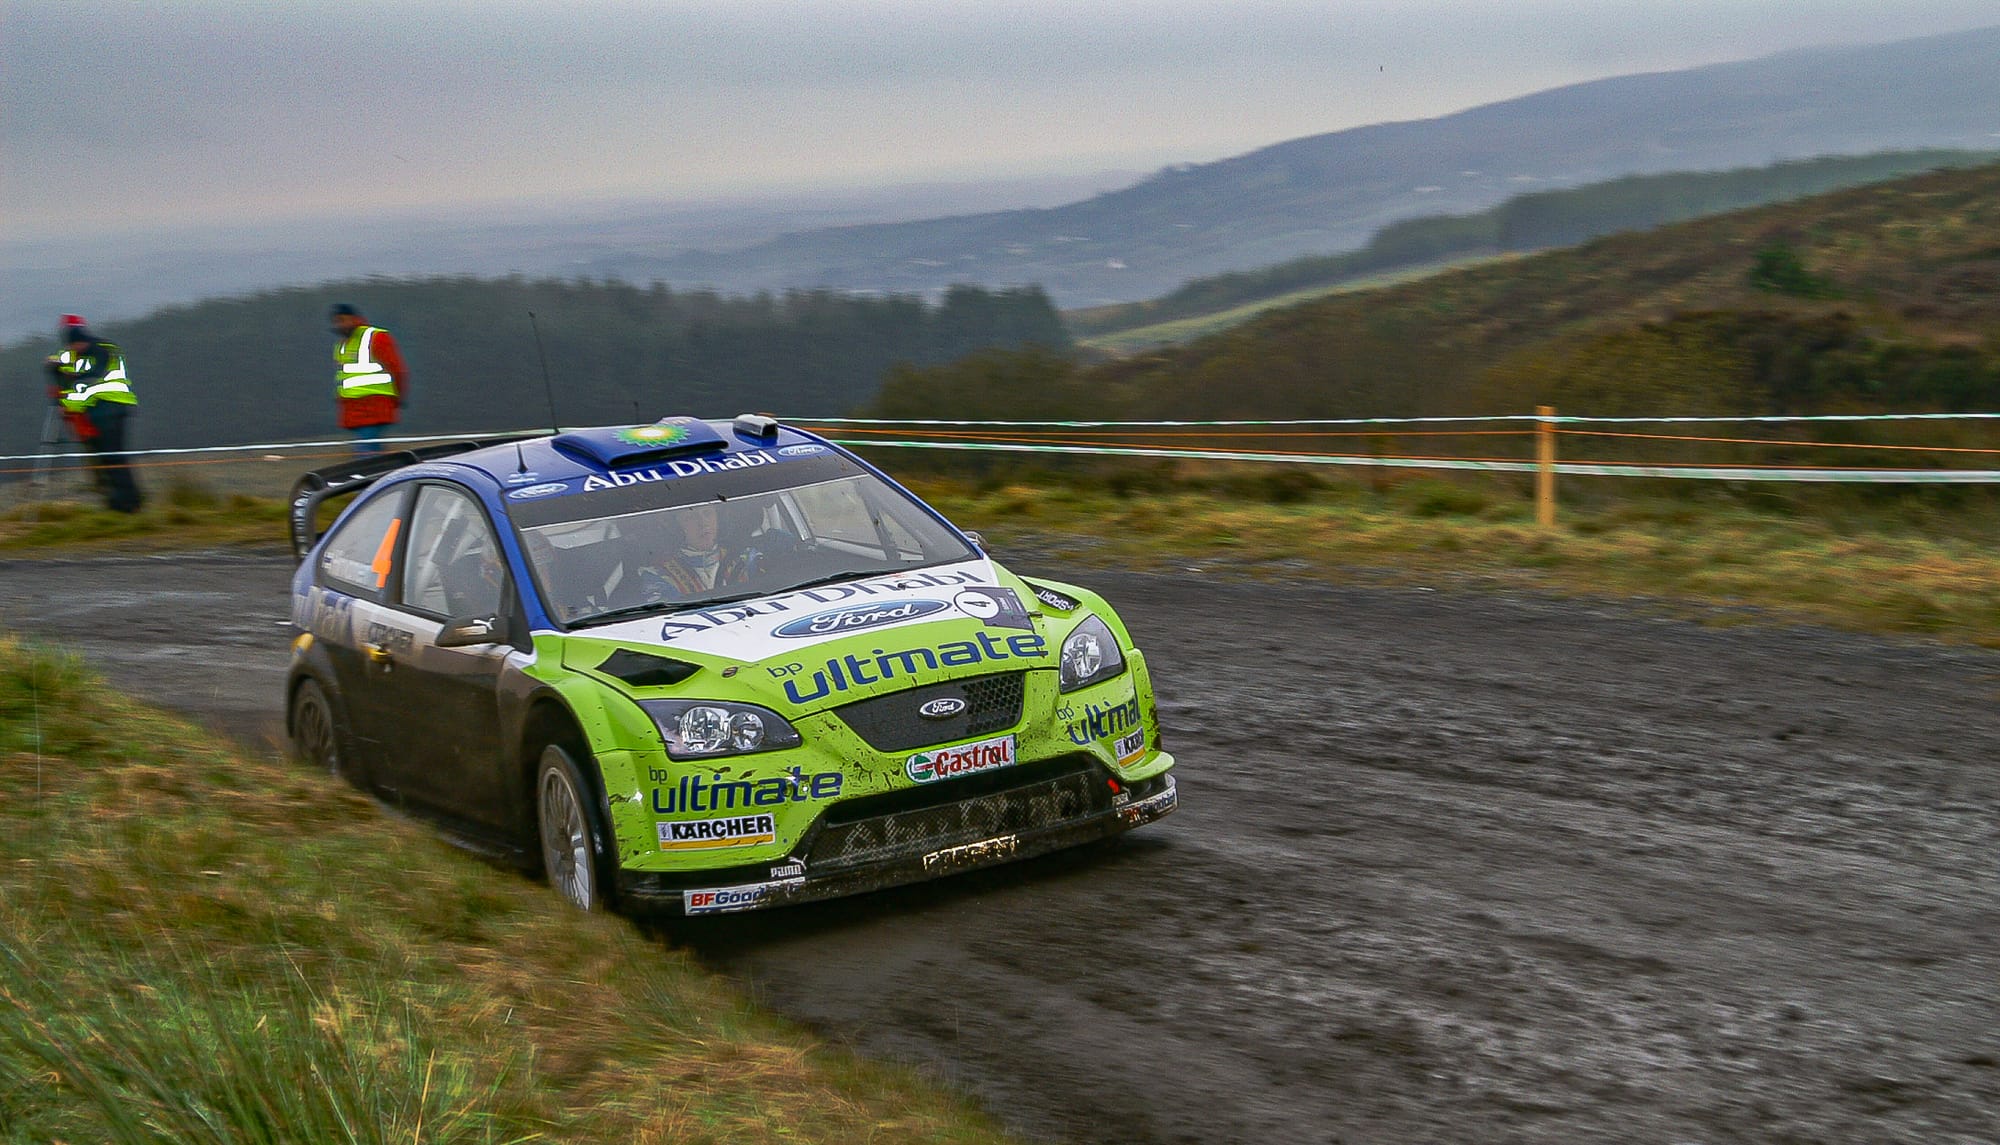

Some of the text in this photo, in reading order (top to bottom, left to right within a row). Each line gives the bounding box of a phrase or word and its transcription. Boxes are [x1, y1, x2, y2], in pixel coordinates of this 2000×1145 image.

[583, 449, 778, 492] Abu Dhabi
[661, 571, 986, 641] Abu Dhabi
[809, 603, 920, 632] Ford
[766, 660, 803, 678] bp
[783, 631, 1048, 704] ultimate
[1055, 705, 1075, 720] bp
[649, 765, 668, 784] bp
[936, 740, 1010, 775] Castrol
[653, 766, 843, 813] ultimate
